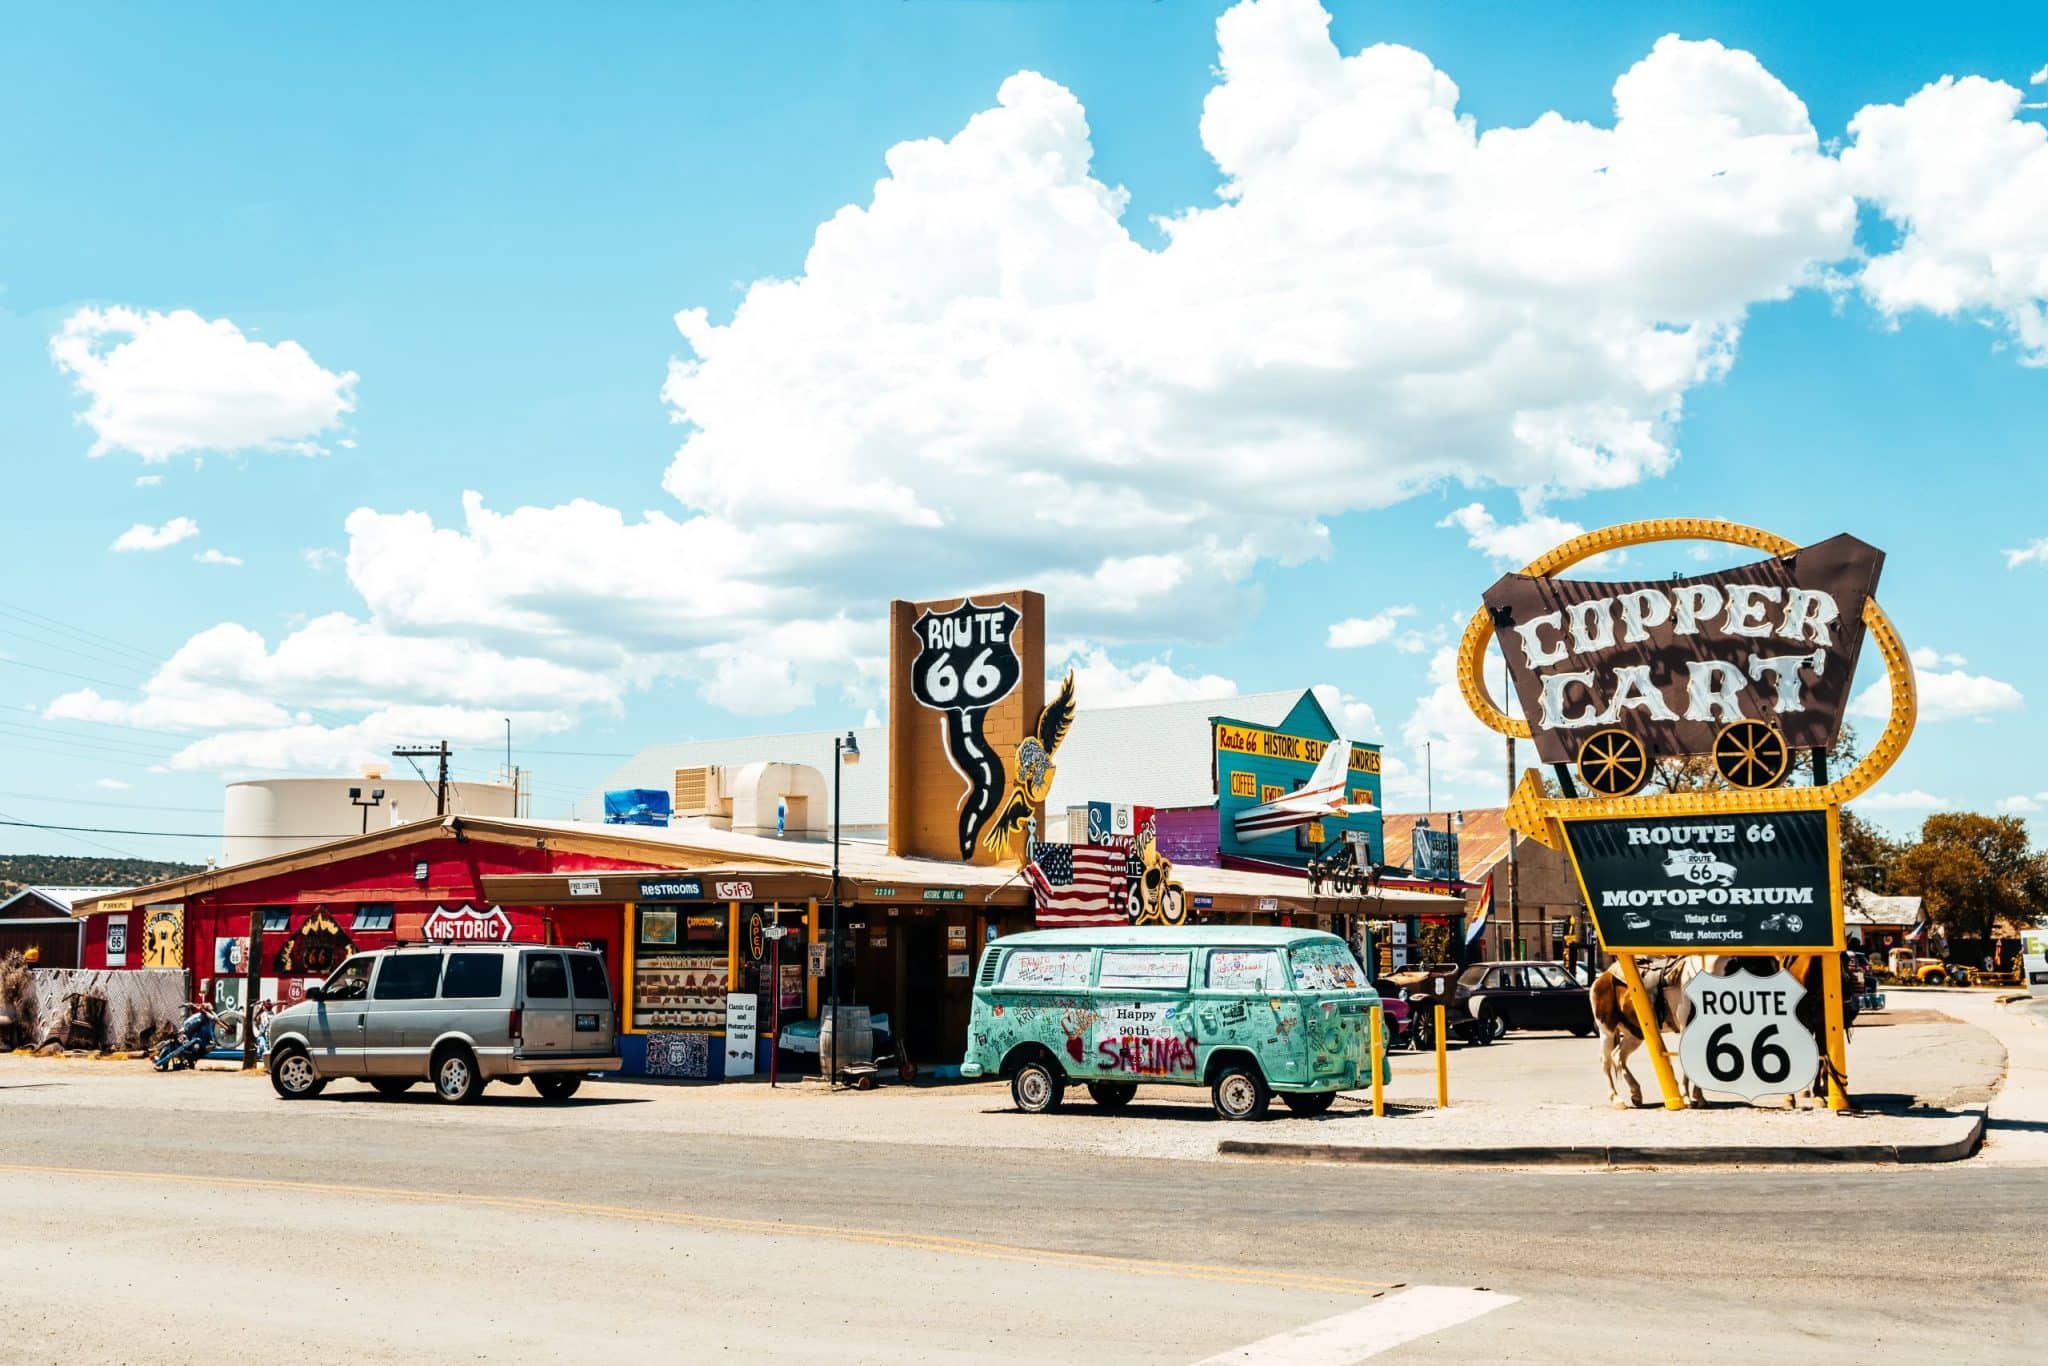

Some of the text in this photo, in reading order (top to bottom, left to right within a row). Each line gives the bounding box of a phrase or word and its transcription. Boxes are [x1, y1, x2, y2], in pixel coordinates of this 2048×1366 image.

[928, 611, 1005, 649] ROUTE
[1514, 584, 1839, 669] COPPER
[926, 648, 1001, 702] 66
[1538, 648, 1826, 730] CART
[1220, 727, 1244, 751] Route
[1246, 731, 1257, 752] 66
[1264, 733, 1300, 758] HISTORIC
[1232, 773, 1255, 796] COFFEE
[1627, 823, 1776, 845] ROUTE 66
[1689, 864, 1712, 880] 66
[1602, 887, 1814, 907] MOTOPORIUM
[434, 919, 499, 940] HISTORIC
[1684, 913, 1728, 925] Vintage Cars
[111, 937, 122, 949] 66
[1670, 929, 1744, 941] Vintage Motorcycles
[1116, 1008, 1157, 1020] Happy
[1702, 990, 1788, 1016] ROUTE
[1119, 1025, 1150, 1036] 90th
[1705, 1023, 1792, 1083] 66
